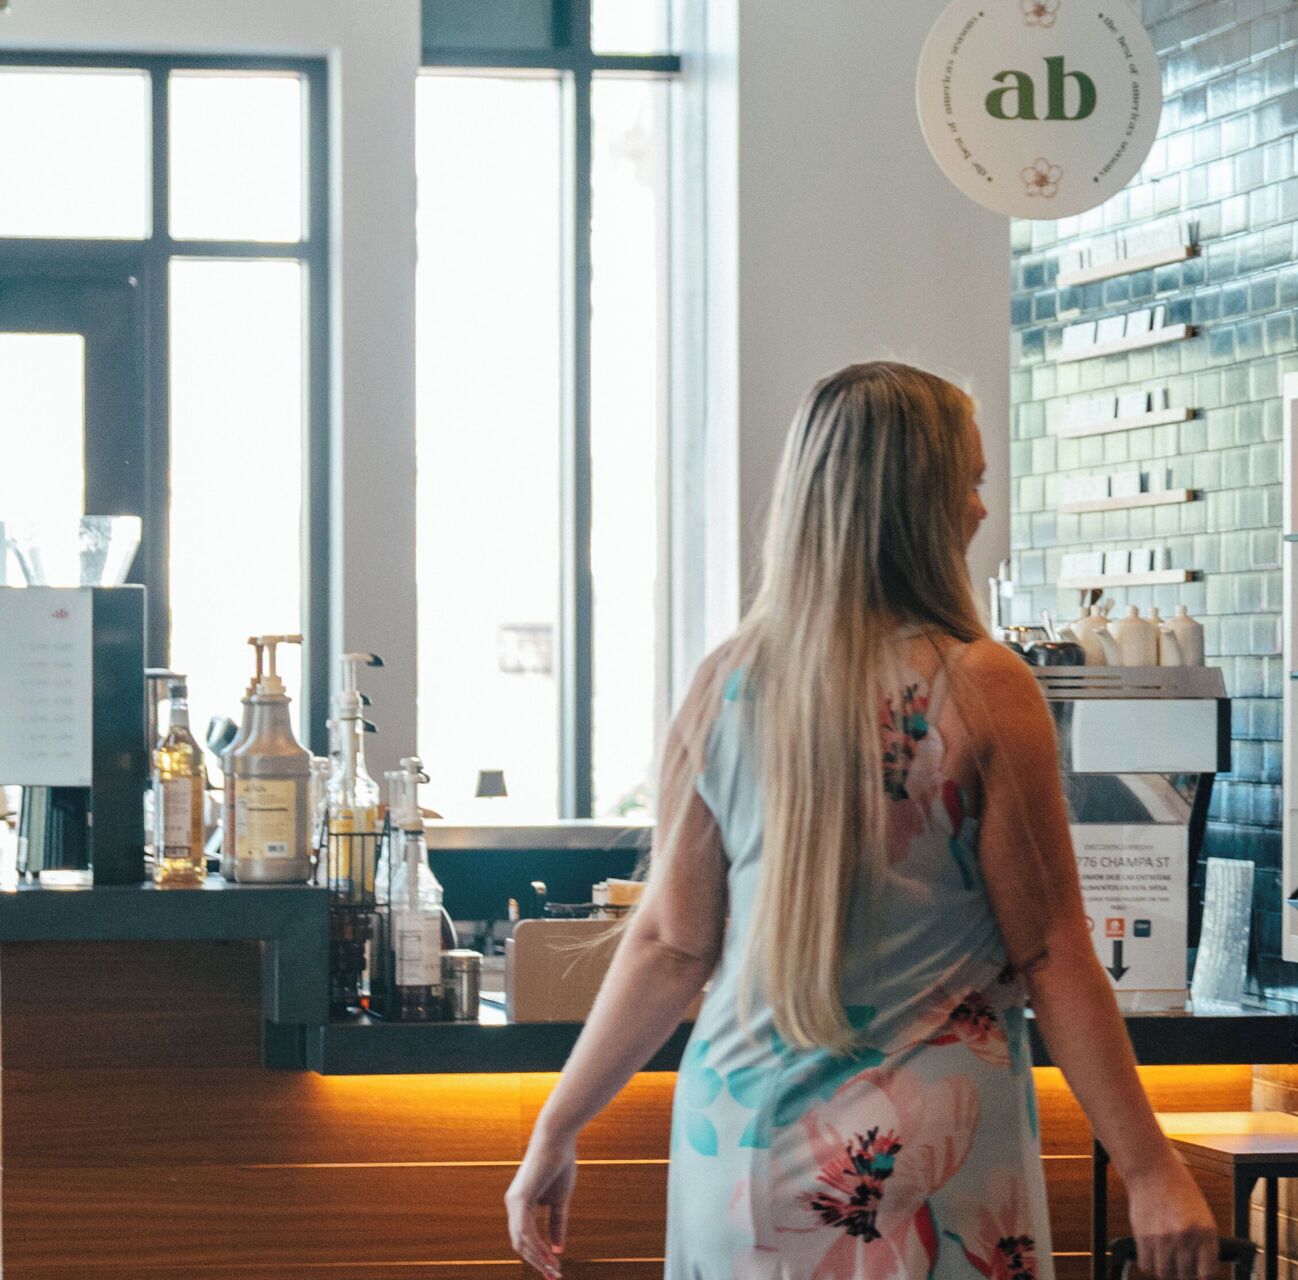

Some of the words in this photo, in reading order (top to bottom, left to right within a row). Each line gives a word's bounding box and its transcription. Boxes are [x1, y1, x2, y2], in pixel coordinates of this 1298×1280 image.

[1104, 17, 1118, 33] the
[1117, 36, 1133, 59] best
[985, 55, 1097, 121] ab
[954, 136, 972, 161] best
[1156, 857, 1170, 868] ST
